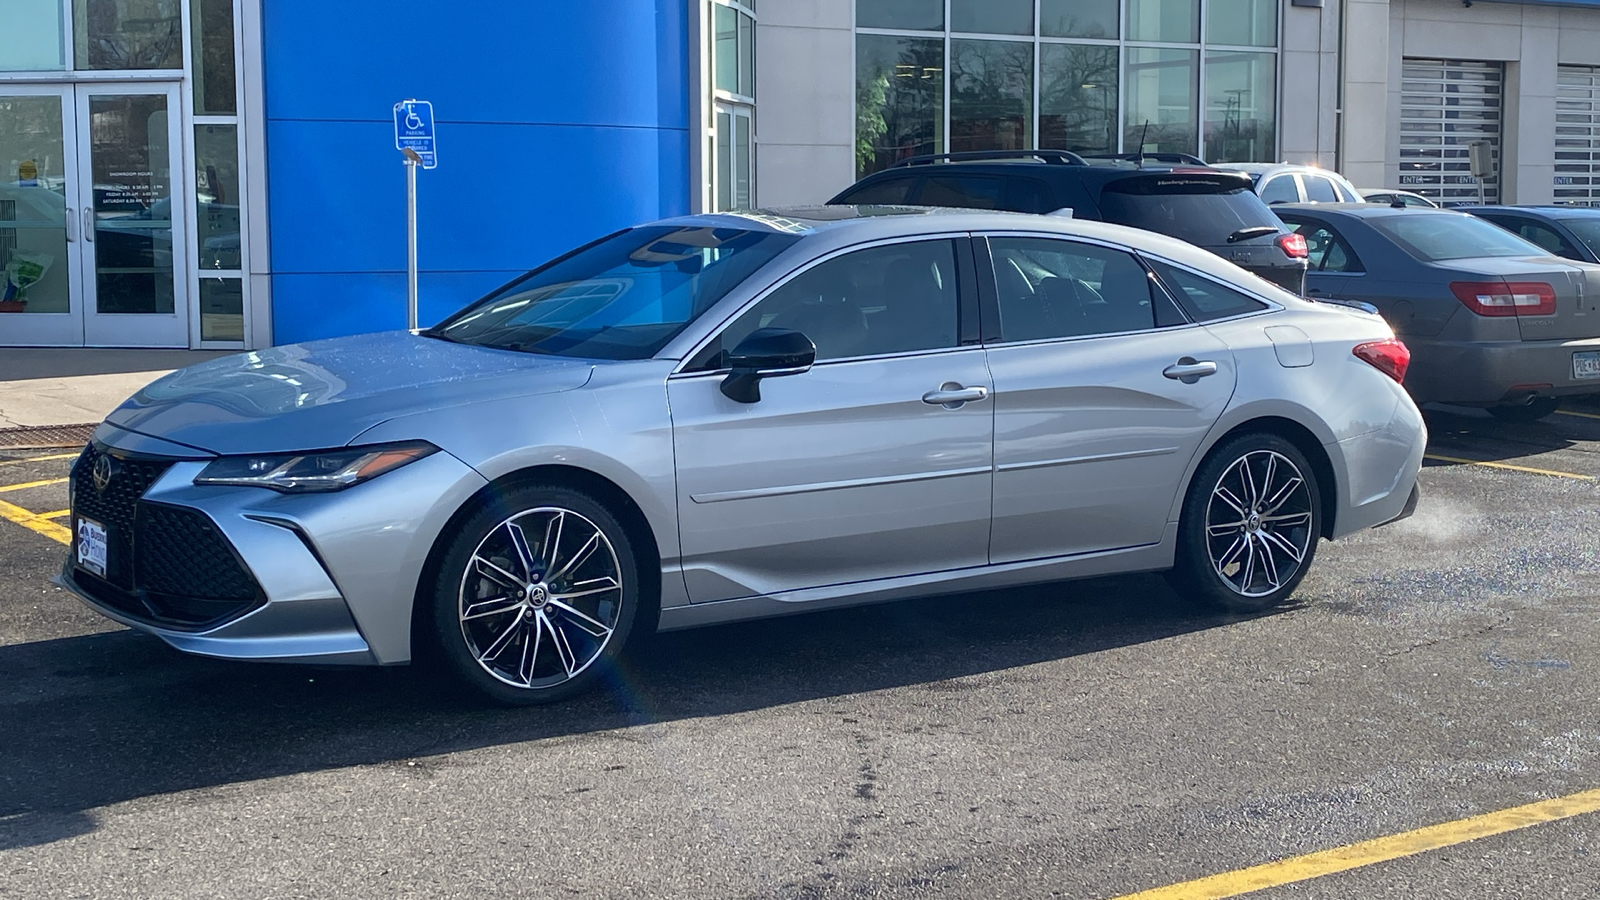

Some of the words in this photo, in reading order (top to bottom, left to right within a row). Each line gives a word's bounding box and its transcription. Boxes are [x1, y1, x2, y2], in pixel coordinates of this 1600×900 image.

[1402, 176, 1424, 184] ENTER
[1460, 176, 1478, 184] ENTE
[1230, 250, 1251, 263] Jeep
